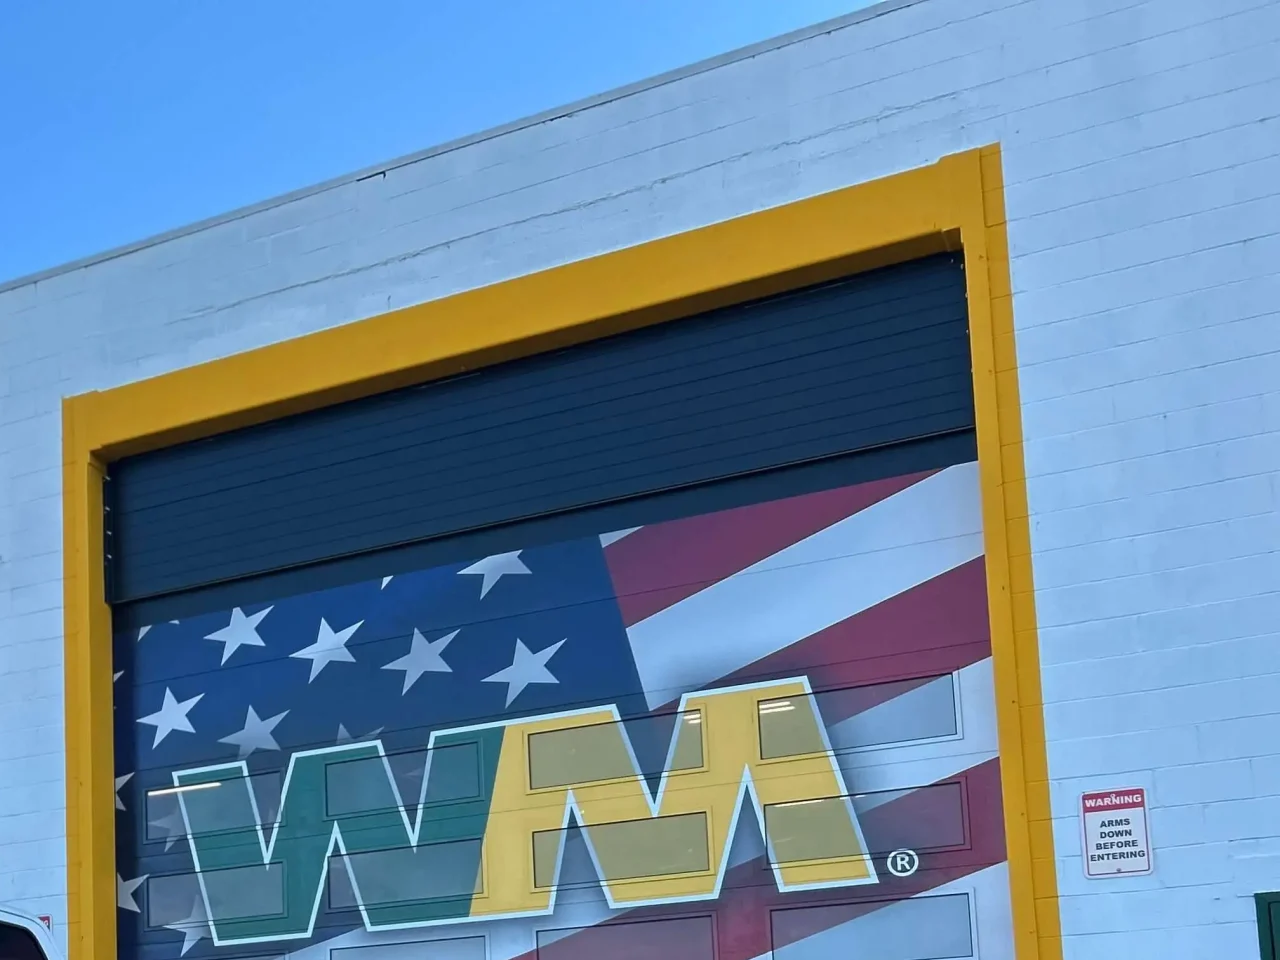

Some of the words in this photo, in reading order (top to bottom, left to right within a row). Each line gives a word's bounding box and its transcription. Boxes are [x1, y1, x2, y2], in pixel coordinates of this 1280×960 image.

[1084, 794, 1142, 808] WARNING
[172, 674, 879, 947] WM
[1100, 818, 1130, 828] ARMS
[1100, 829, 1132, 839] DOWN
[1096, 840, 1138, 850] BEFORE
[1090, 850, 1145, 862] ENTERING
